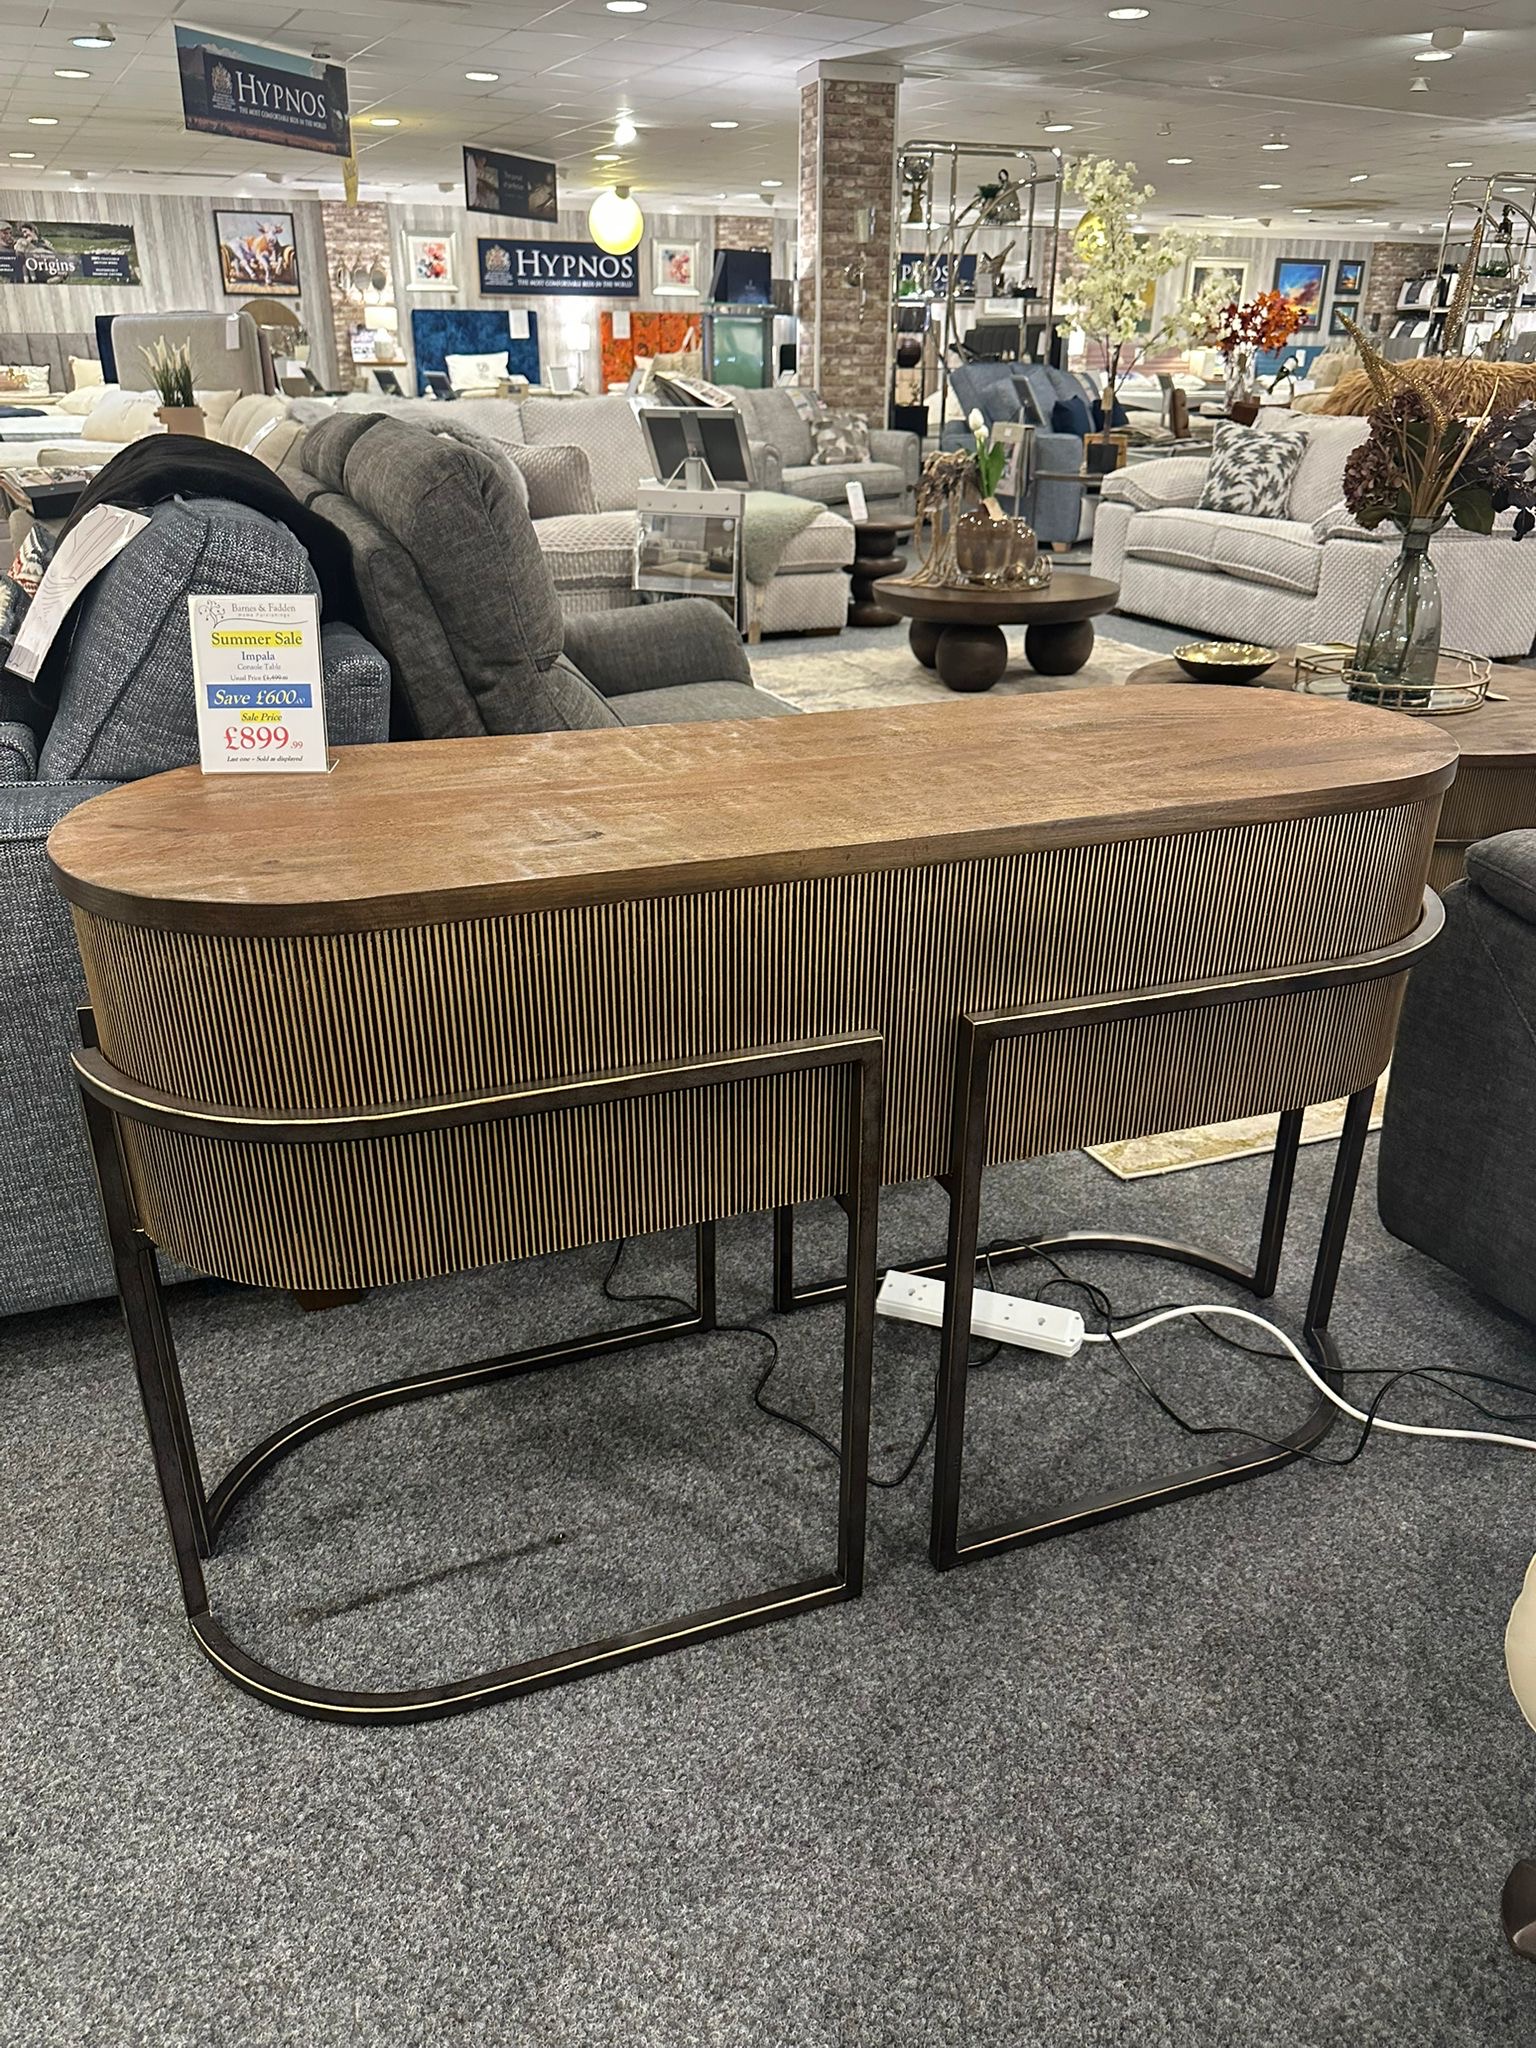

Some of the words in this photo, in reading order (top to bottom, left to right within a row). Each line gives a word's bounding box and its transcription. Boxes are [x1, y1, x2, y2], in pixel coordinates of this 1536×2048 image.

[235, 70, 327, 119] HYPNOS
[25, 257, 76, 275] Origins
[515, 249, 634, 279] HYPNOS
[232, 603, 257, 613] Barnes
[258, 604, 266, 613] &
[268, 602, 296, 613] Fadden
[211, 632, 272, 646] Summer
[274, 631, 303, 646] Sale
[241, 651, 275, 663] Impala
[237, 663, 263, 671] Console
[264, 663, 281, 671] Table
[213, 689, 251, 705] Save
[241, 712, 259, 722] Sale
[260, 712, 282, 722] Price
